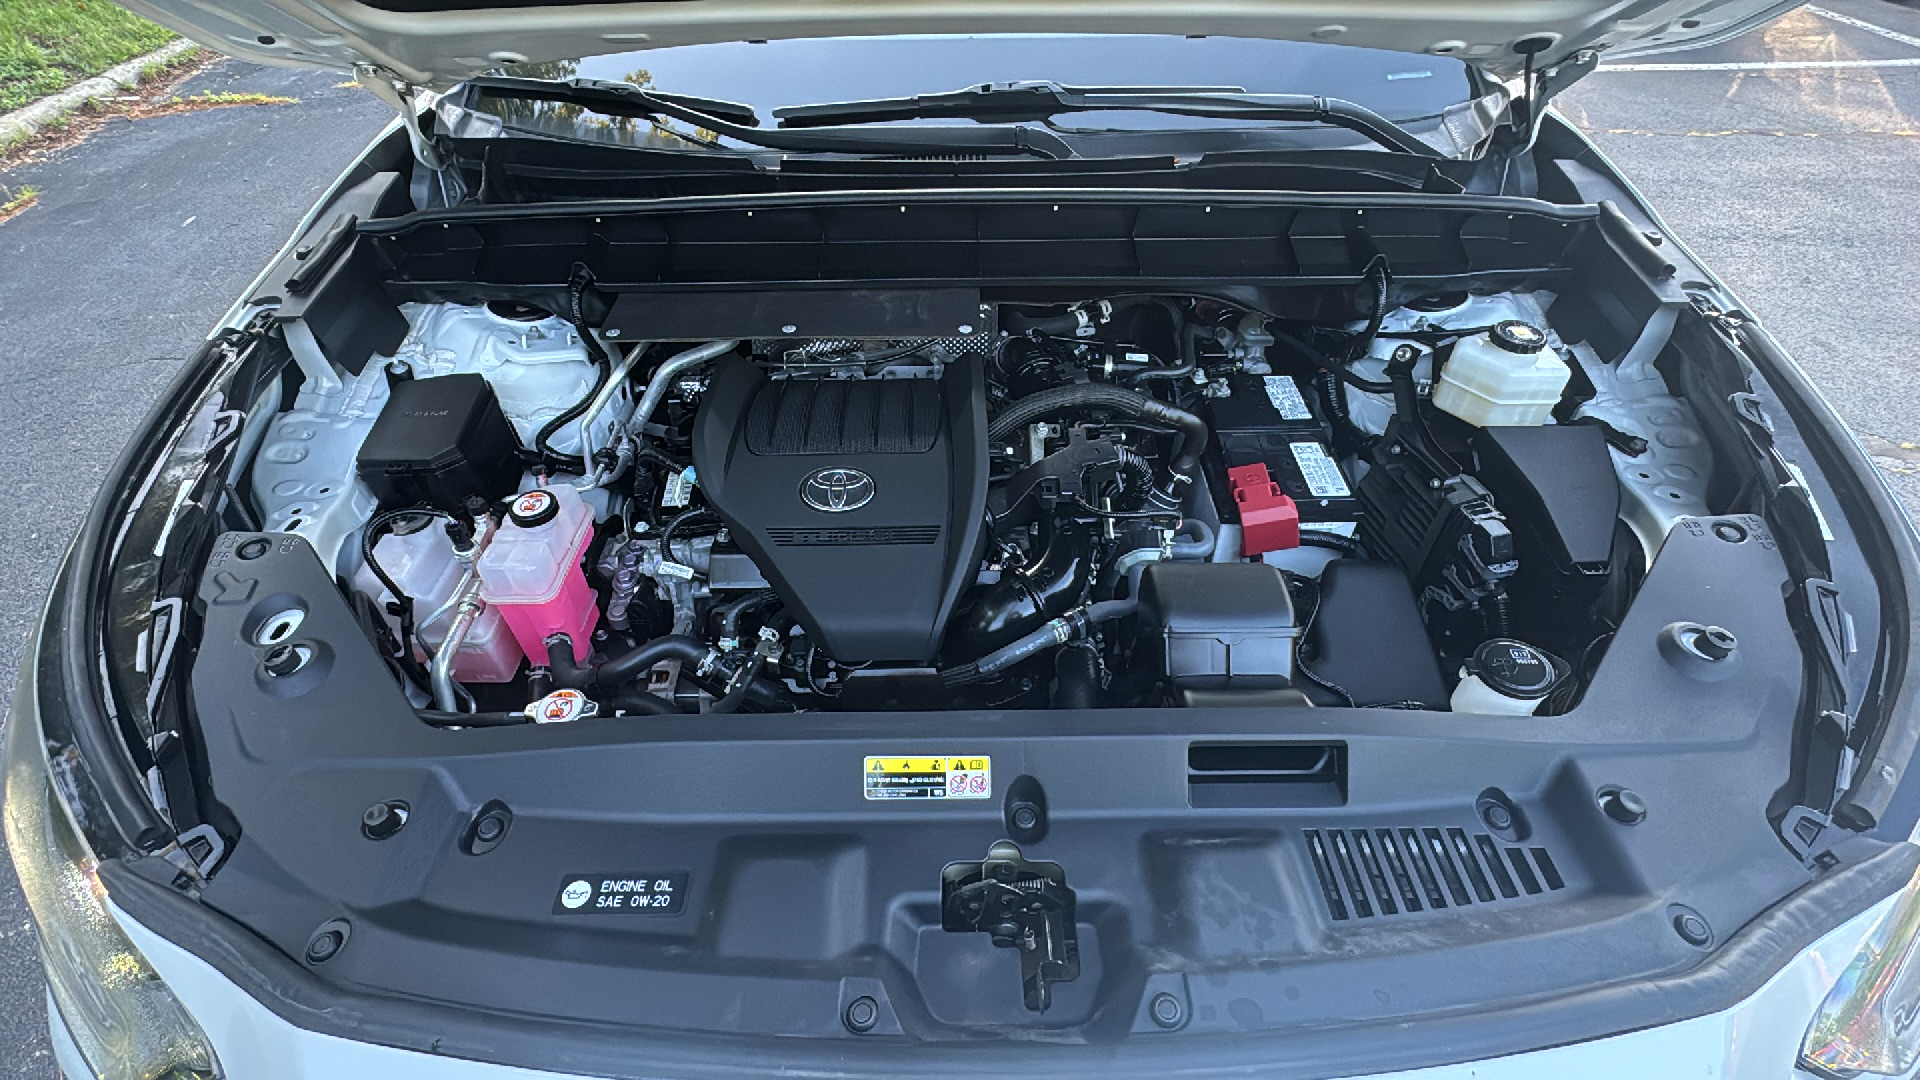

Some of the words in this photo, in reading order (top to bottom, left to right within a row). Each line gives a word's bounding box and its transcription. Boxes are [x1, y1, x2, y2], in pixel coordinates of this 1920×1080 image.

[600, 880, 648, 892] ENGINE
[653, 879, 673, 892] OIL
[596, 895, 624, 908] SAE
[630, 895, 671, 907] 0W-20
